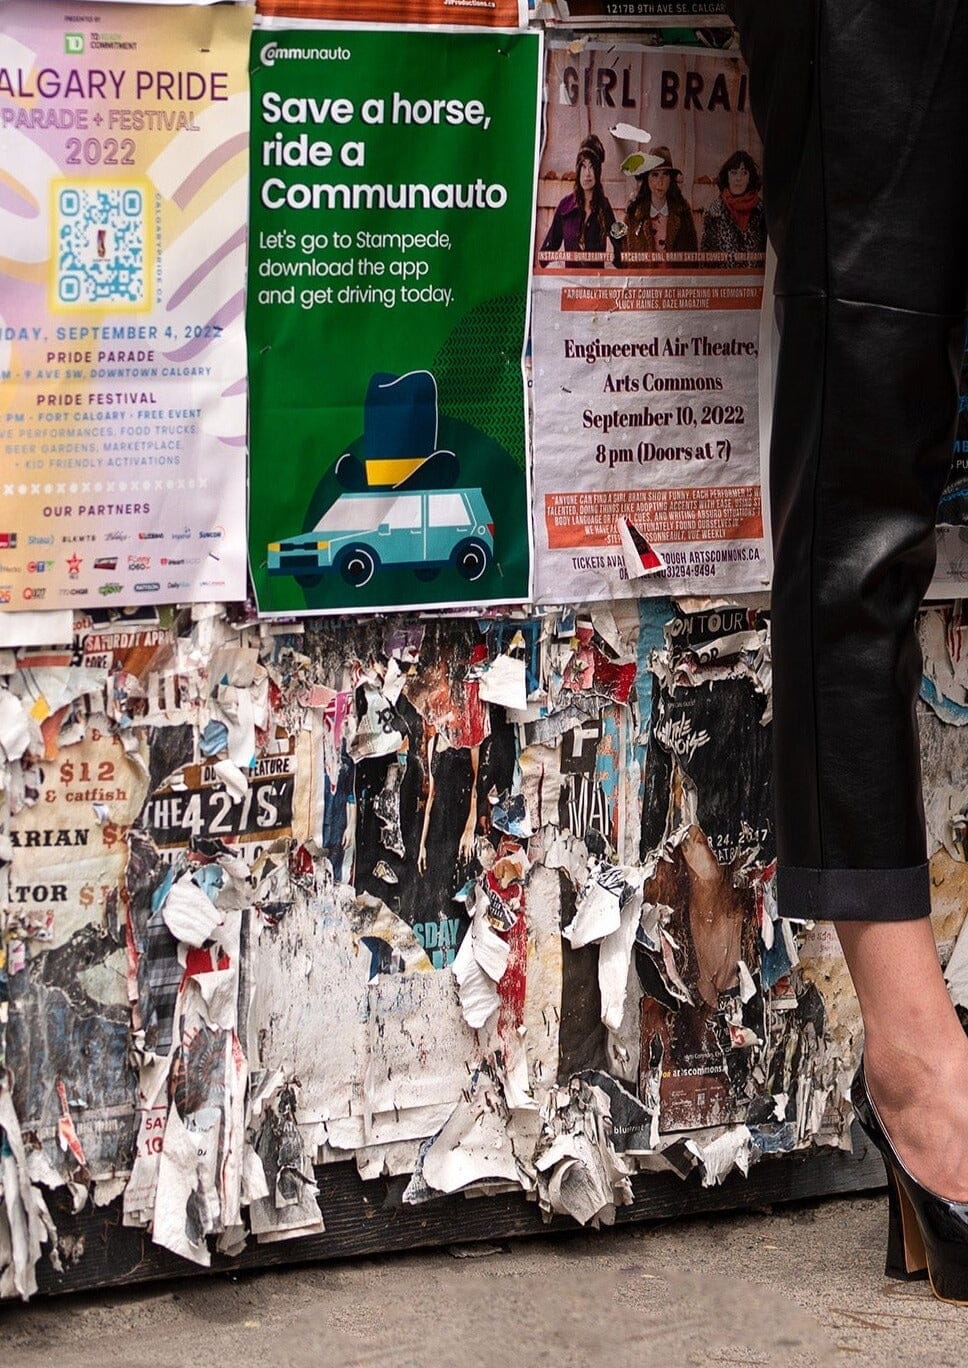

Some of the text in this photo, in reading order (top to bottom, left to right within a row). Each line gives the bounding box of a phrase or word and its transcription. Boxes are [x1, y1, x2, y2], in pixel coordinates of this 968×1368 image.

[260, 42, 351, 66] Communauto
[1, 107, 88, 131] PARADE
[108, 109, 200, 132] FESTIVAL
[262, 92, 491, 130] Save a horse,
[66, 137, 136, 165] 2022
[263, 132, 364, 166] ride a
[261, 178, 507, 209] Communauto
[259, 258, 429, 280] download the app
[258, 284, 454, 309] and get driving today.
[56, 325, 222, 340] SEPTEMBER 4, 2022
[47, 351, 155, 363] PRIDE PARADE
[565, 337, 759, 363] Engineered Air Theatre,
[604, 373, 723, 392] Arts Commons
[37, 392, 157, 406] PRIDE FESTIVAL
[38, 409, 202, 421] FORT CALGARY FREE EVENT
[583, 406, 745, 433] September 10, 2022
[43, 502, 150, 517] OUR PARTNERS
[572, 548, 760, 569] TICKETS ARTSCOMMONS.CA
[60, 761, 115, 786] $12
[65, 787, 127, 802] catfish
